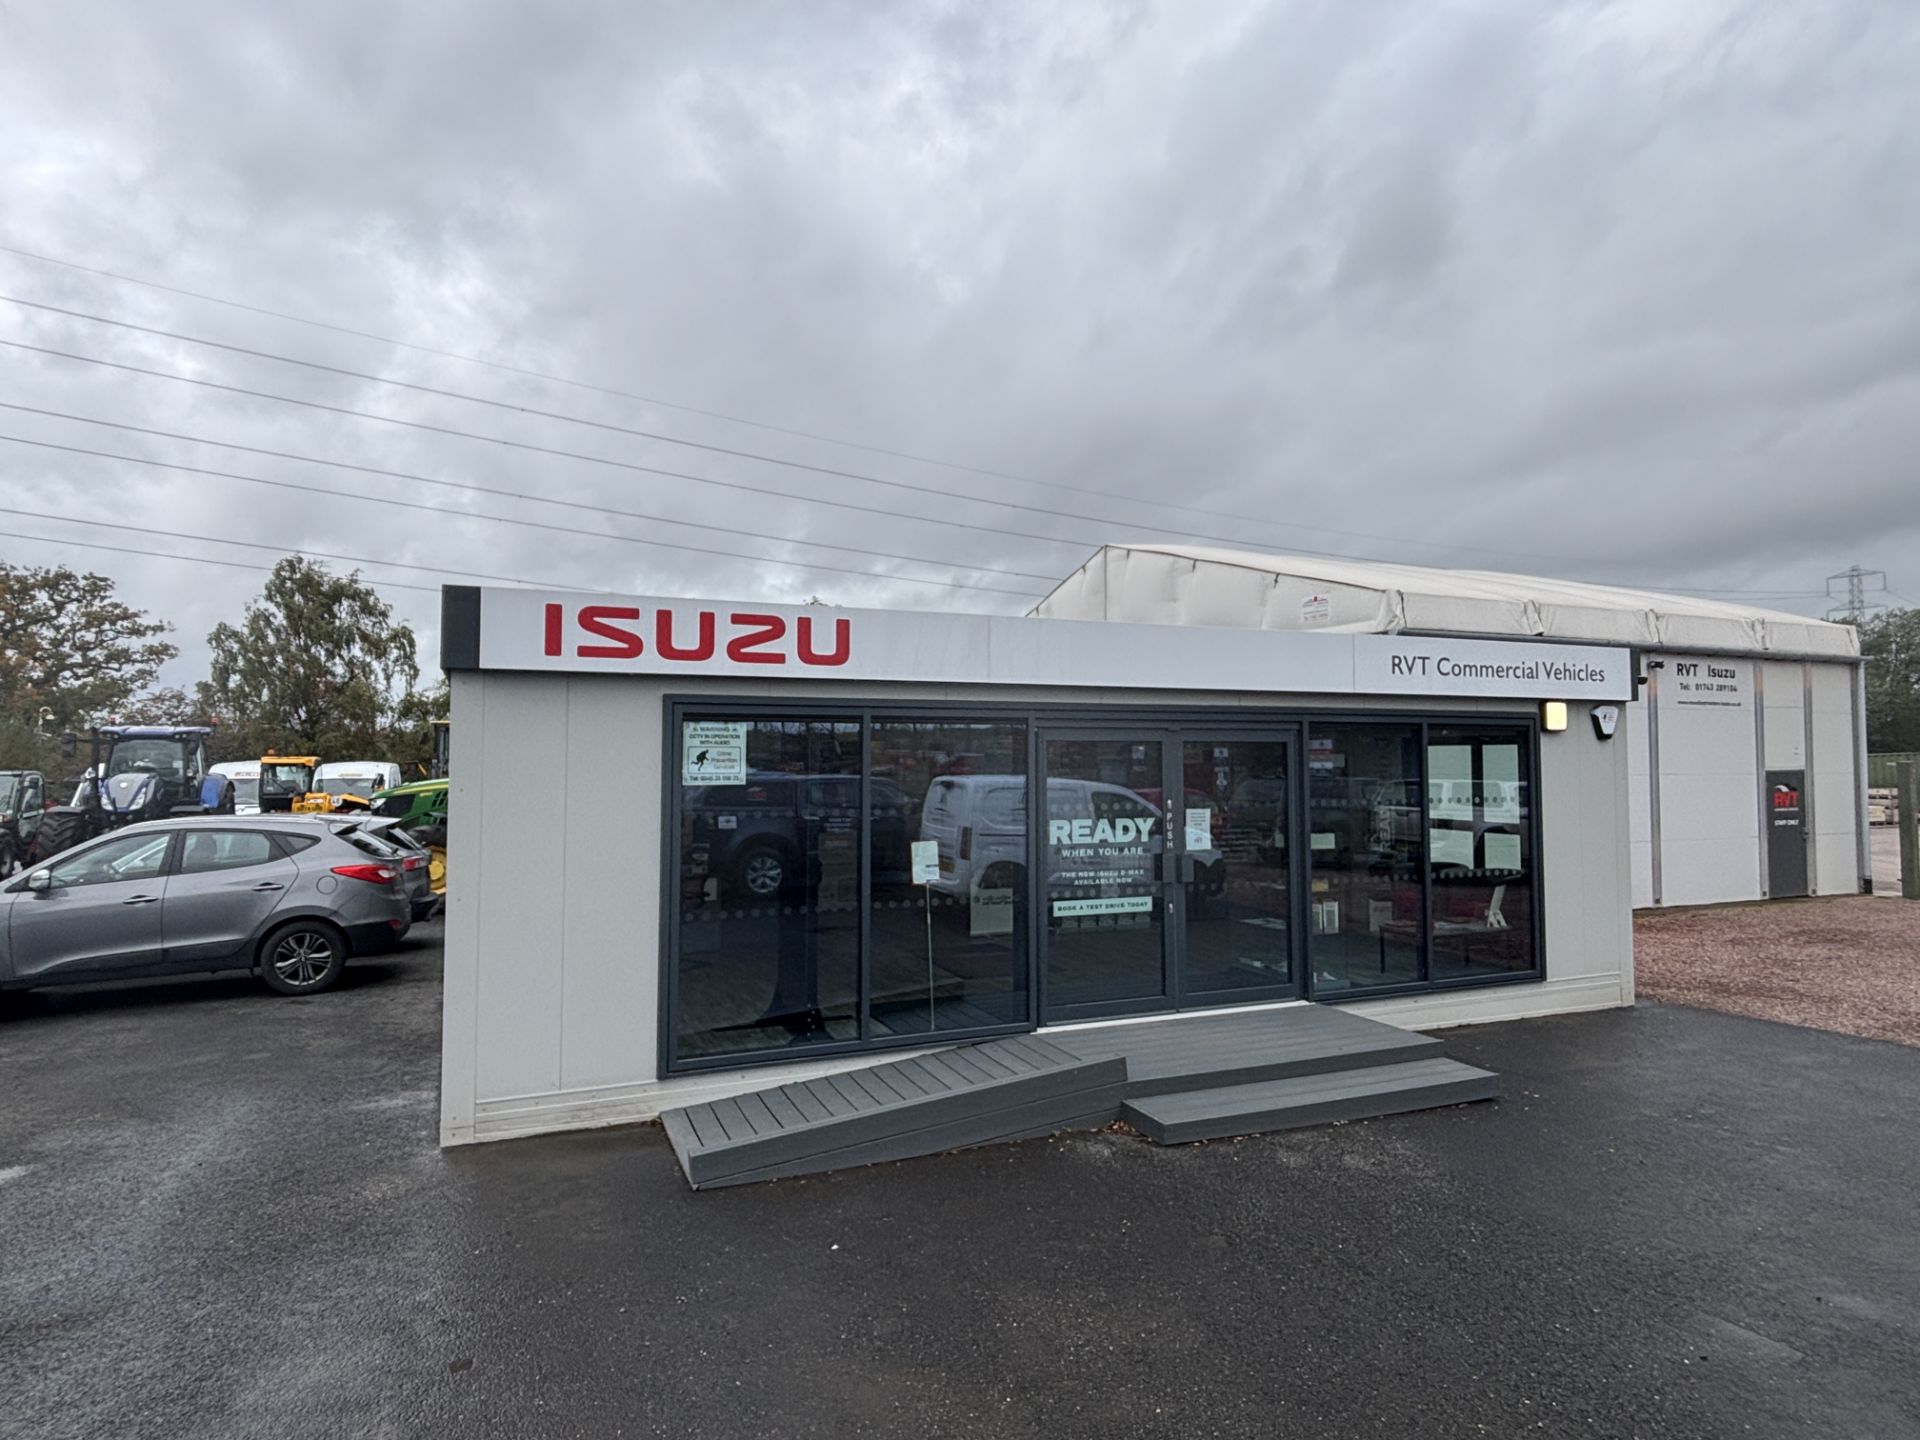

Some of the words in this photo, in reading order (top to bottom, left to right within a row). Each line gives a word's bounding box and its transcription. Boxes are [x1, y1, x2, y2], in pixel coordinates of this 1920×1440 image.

[545, 603, 850, 666] ISUZU
[1391, 655, 1430, 676] RVT
[1437, 657, 1539, 680] Commercial
[1543, 661, 1606, 682] Vehicles
[1677, 663, 1698, 677] RVT
[1708, 664, 1735, 679] Isuzu
[1679, 682, 1690, 691] Tel:
[1774, 791, 1799, 807] RVT
[1048, 817, 1155, 845] READY
[1061, 849, 1094, 857] WHEN
[1098, 847, 1119, 856] YOU
[1122, 847, 1143, 855] ARE
